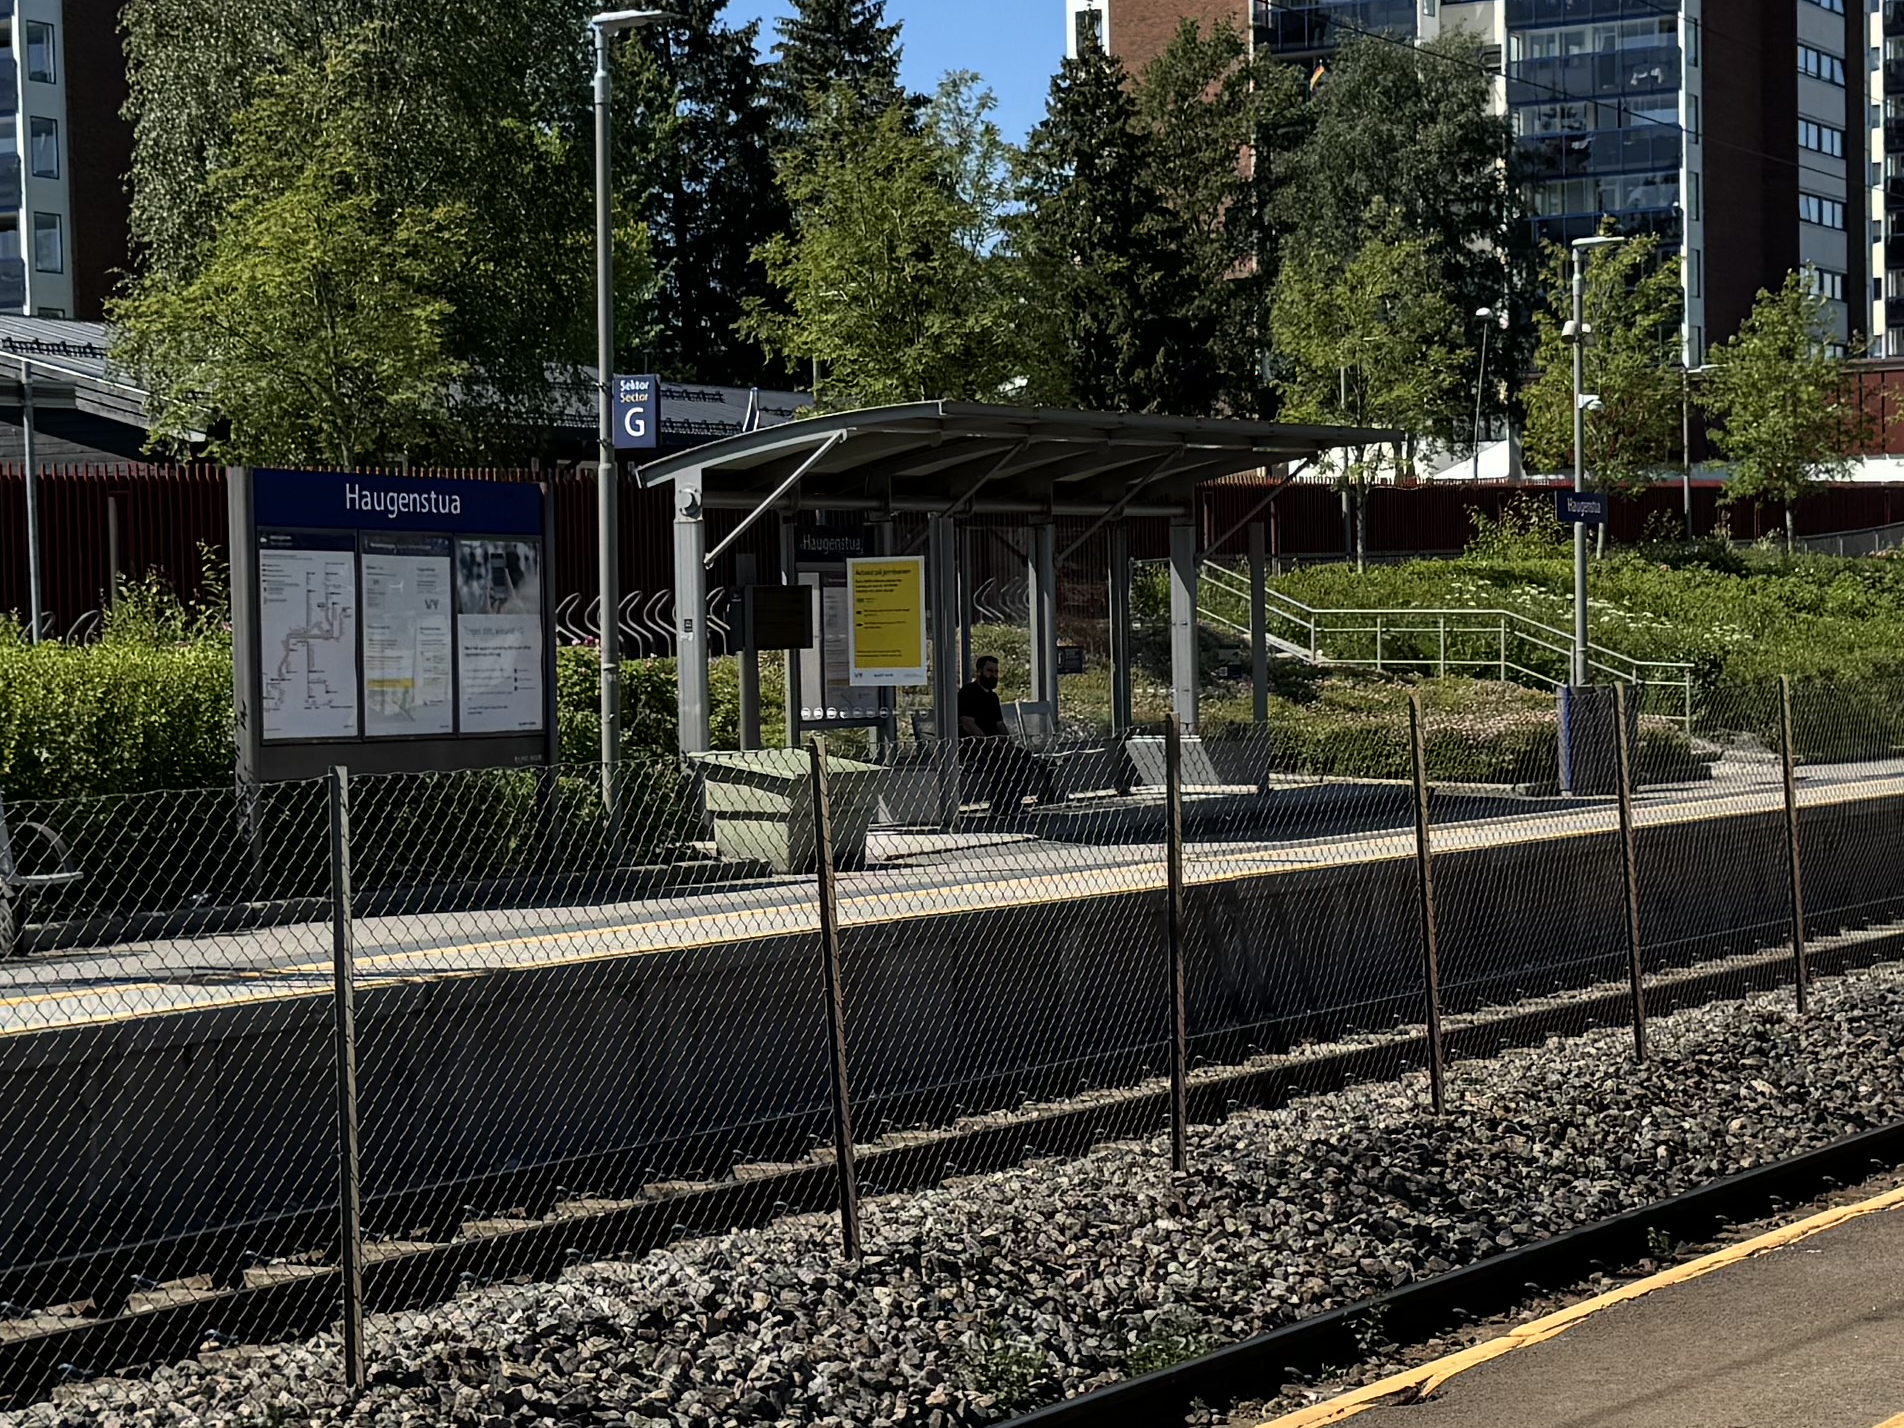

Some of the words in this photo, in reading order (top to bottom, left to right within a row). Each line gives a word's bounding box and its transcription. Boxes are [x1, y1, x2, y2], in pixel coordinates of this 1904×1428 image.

[620, 379, 650, 392] Sektor
[620, 392, 649, 403] Sector
[624, 406, 645, 438] G
[345, 483, 461, 519] Haugenstua
[803, 533, 862, 555] Haugenstua
